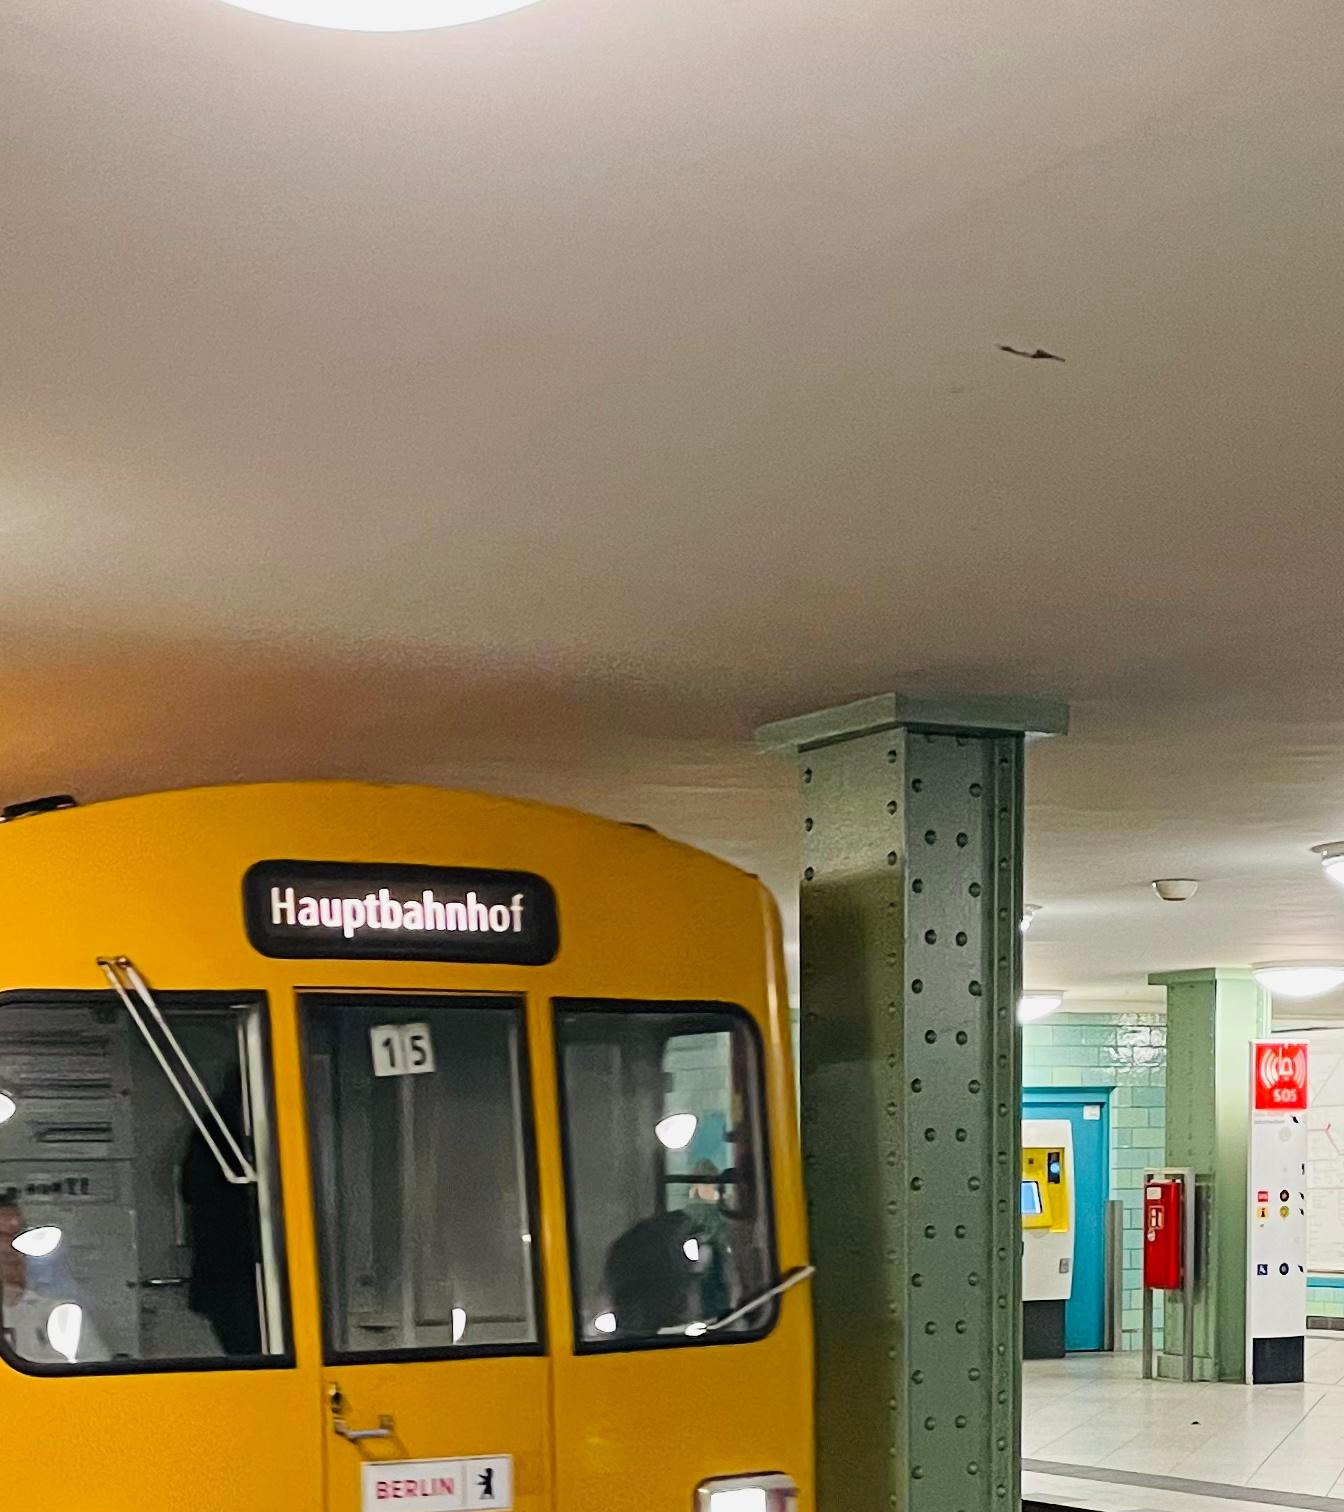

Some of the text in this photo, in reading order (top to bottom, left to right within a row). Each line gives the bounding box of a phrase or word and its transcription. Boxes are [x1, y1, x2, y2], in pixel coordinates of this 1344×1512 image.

[271, 886, 524, 938] Hauptbahnhof
[381, 1034, 427, 1068] 15
[1273, 1088, 1297, 1103] SOS
[375, 1477, 455, 1500] BERLIN
